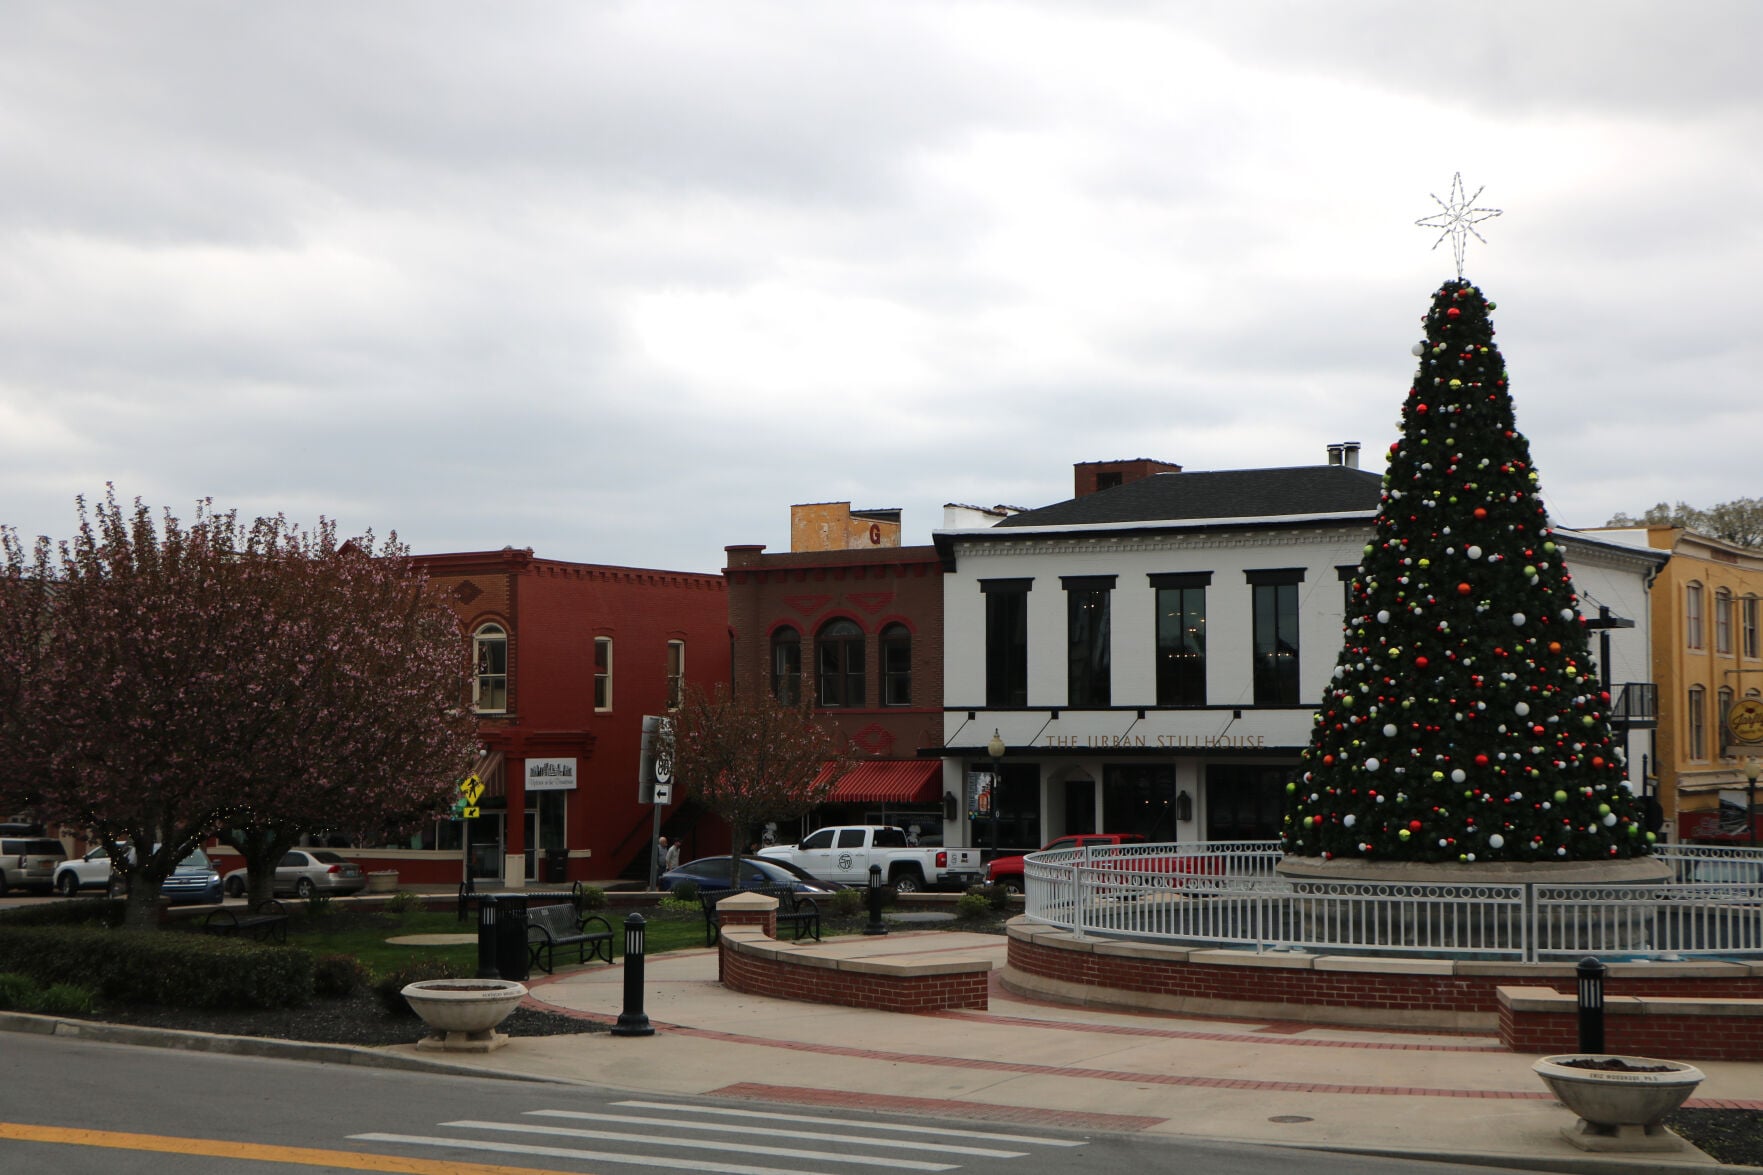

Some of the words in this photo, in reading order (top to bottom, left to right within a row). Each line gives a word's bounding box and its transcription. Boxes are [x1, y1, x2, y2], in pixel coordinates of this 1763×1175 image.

[869, 523, 881, 545] G
[1046, 735, 1078, 749] THE
[1088, 735, 1146, 749] URBAN
[1157, 734, 1265, 749] STILLHOUSE
